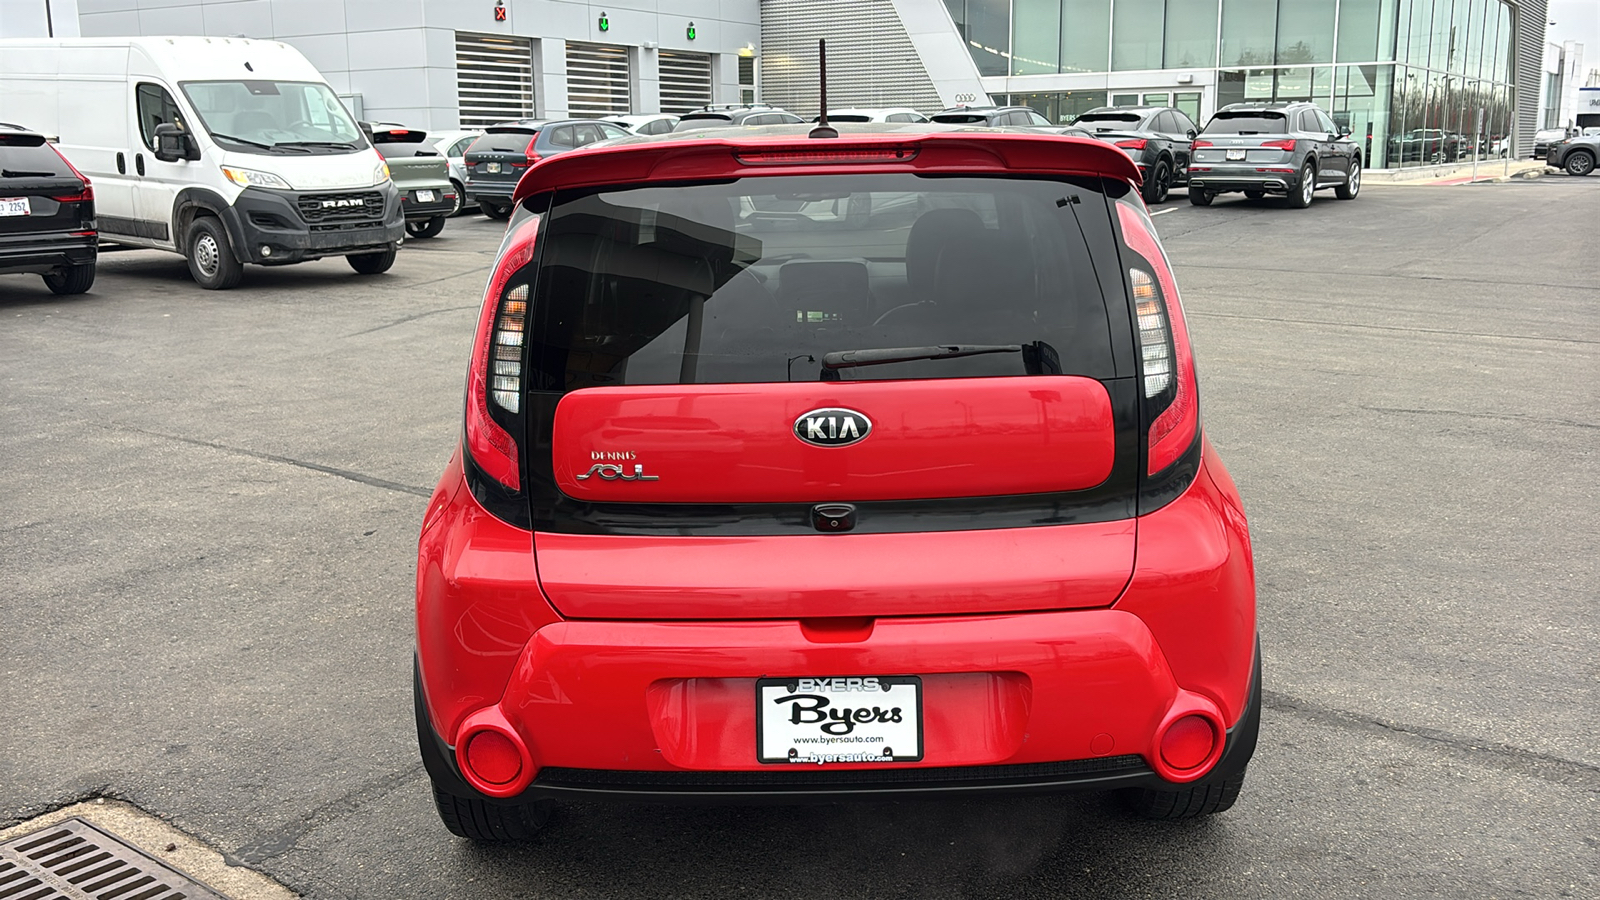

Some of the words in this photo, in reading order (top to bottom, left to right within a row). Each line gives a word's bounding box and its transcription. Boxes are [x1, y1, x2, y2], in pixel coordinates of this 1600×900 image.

[9, 202, 26, 211] 2252
[322, 199, 364, 208] RAM
[806, 416, 860, 439] KIA
[591, 450, 637, 460] DENNIS
[576, 463, 659, 480] SOUL
[798, 677, 880, 693] BYERS
[773, 693, 903, 736] Byers
[793, 735, 884, 746] www.byersauto.com
[789, 751, 893, 765] www.byersauto.com
